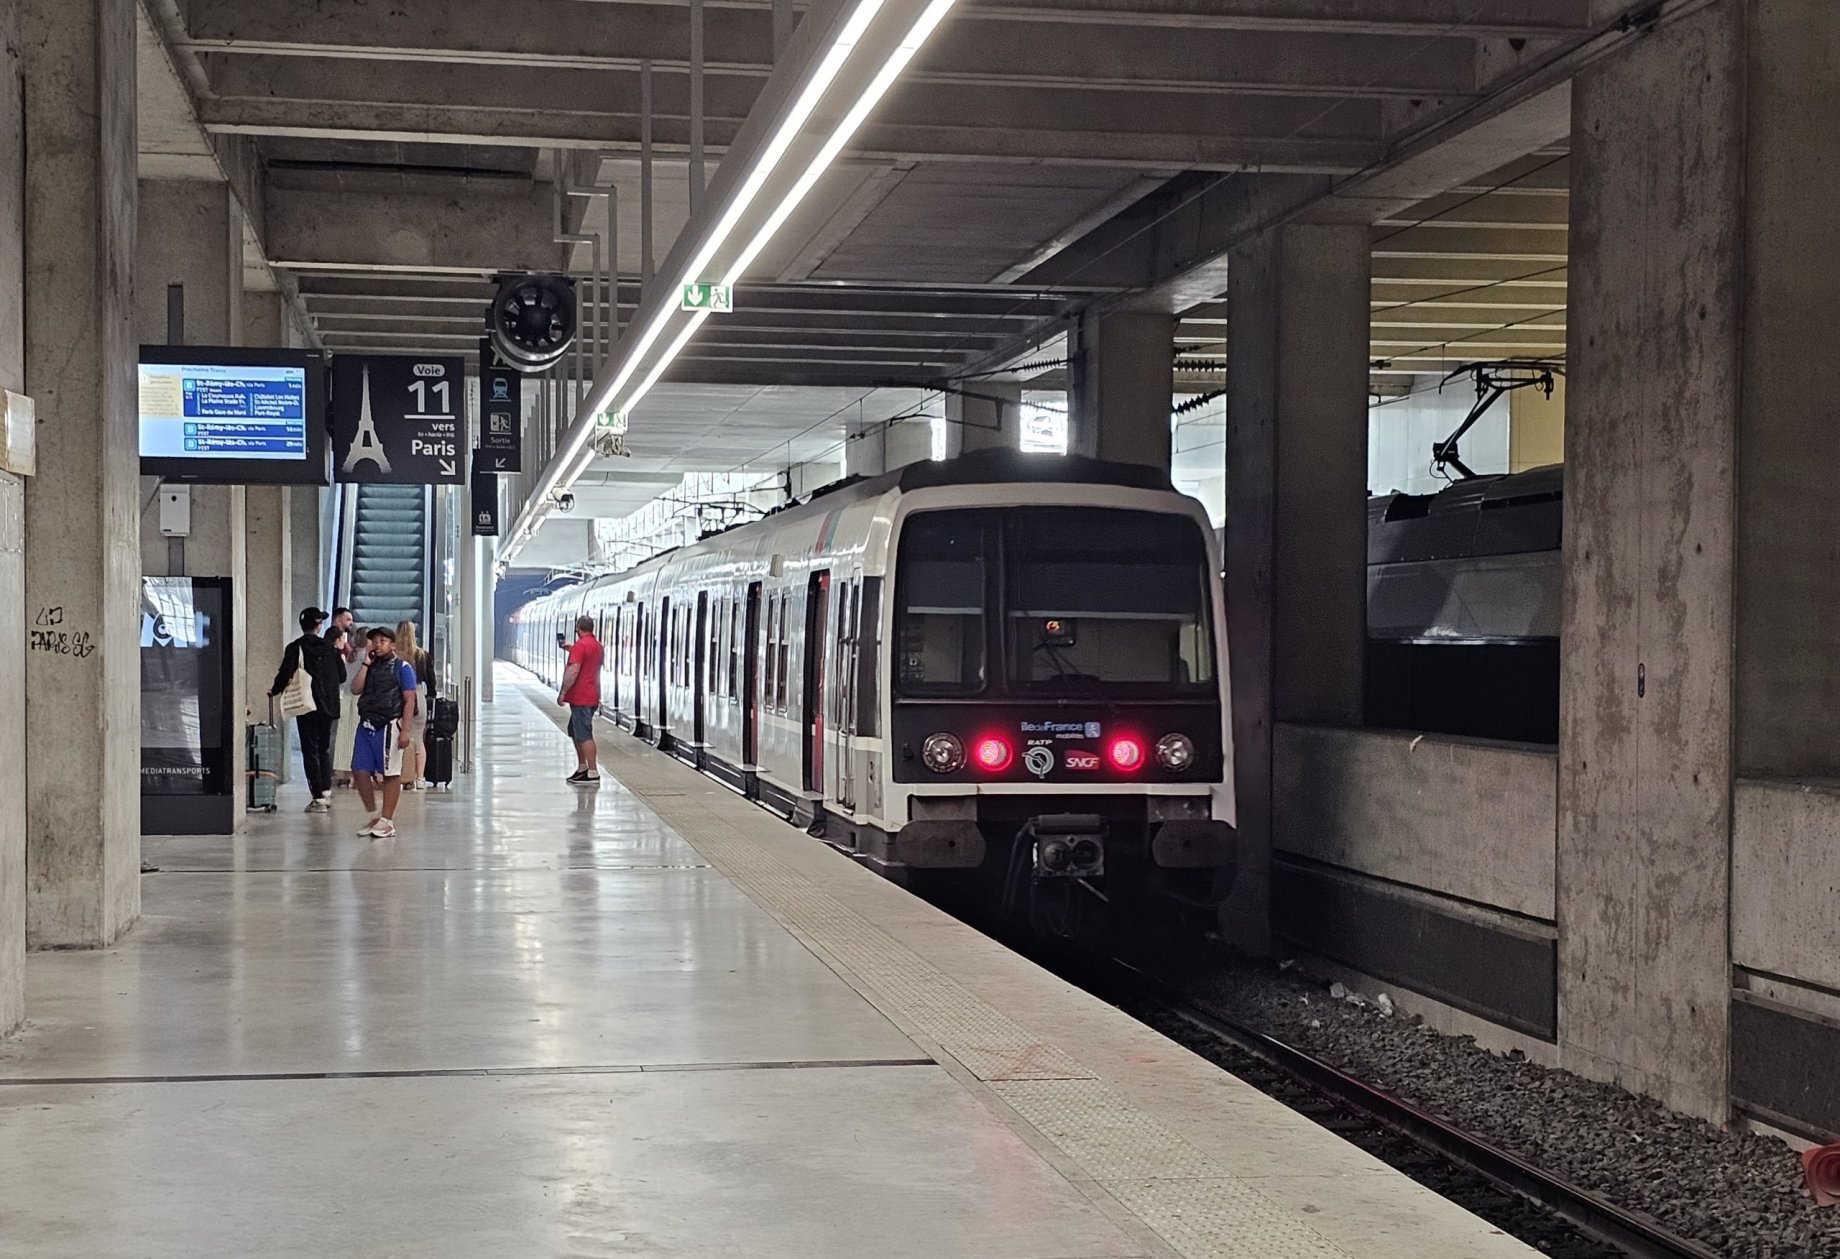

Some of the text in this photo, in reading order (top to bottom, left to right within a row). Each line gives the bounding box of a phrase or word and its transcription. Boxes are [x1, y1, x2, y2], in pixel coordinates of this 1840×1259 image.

[417, 365, 441, 375] Voie
[407, 380, 450, 414] 11
[432, 422, 455, 431] vers
[490, 436, 511, 444] Sortie
[411, 439, 455, 456] Paris
[1065, 757, 1100, 768] SNCF
